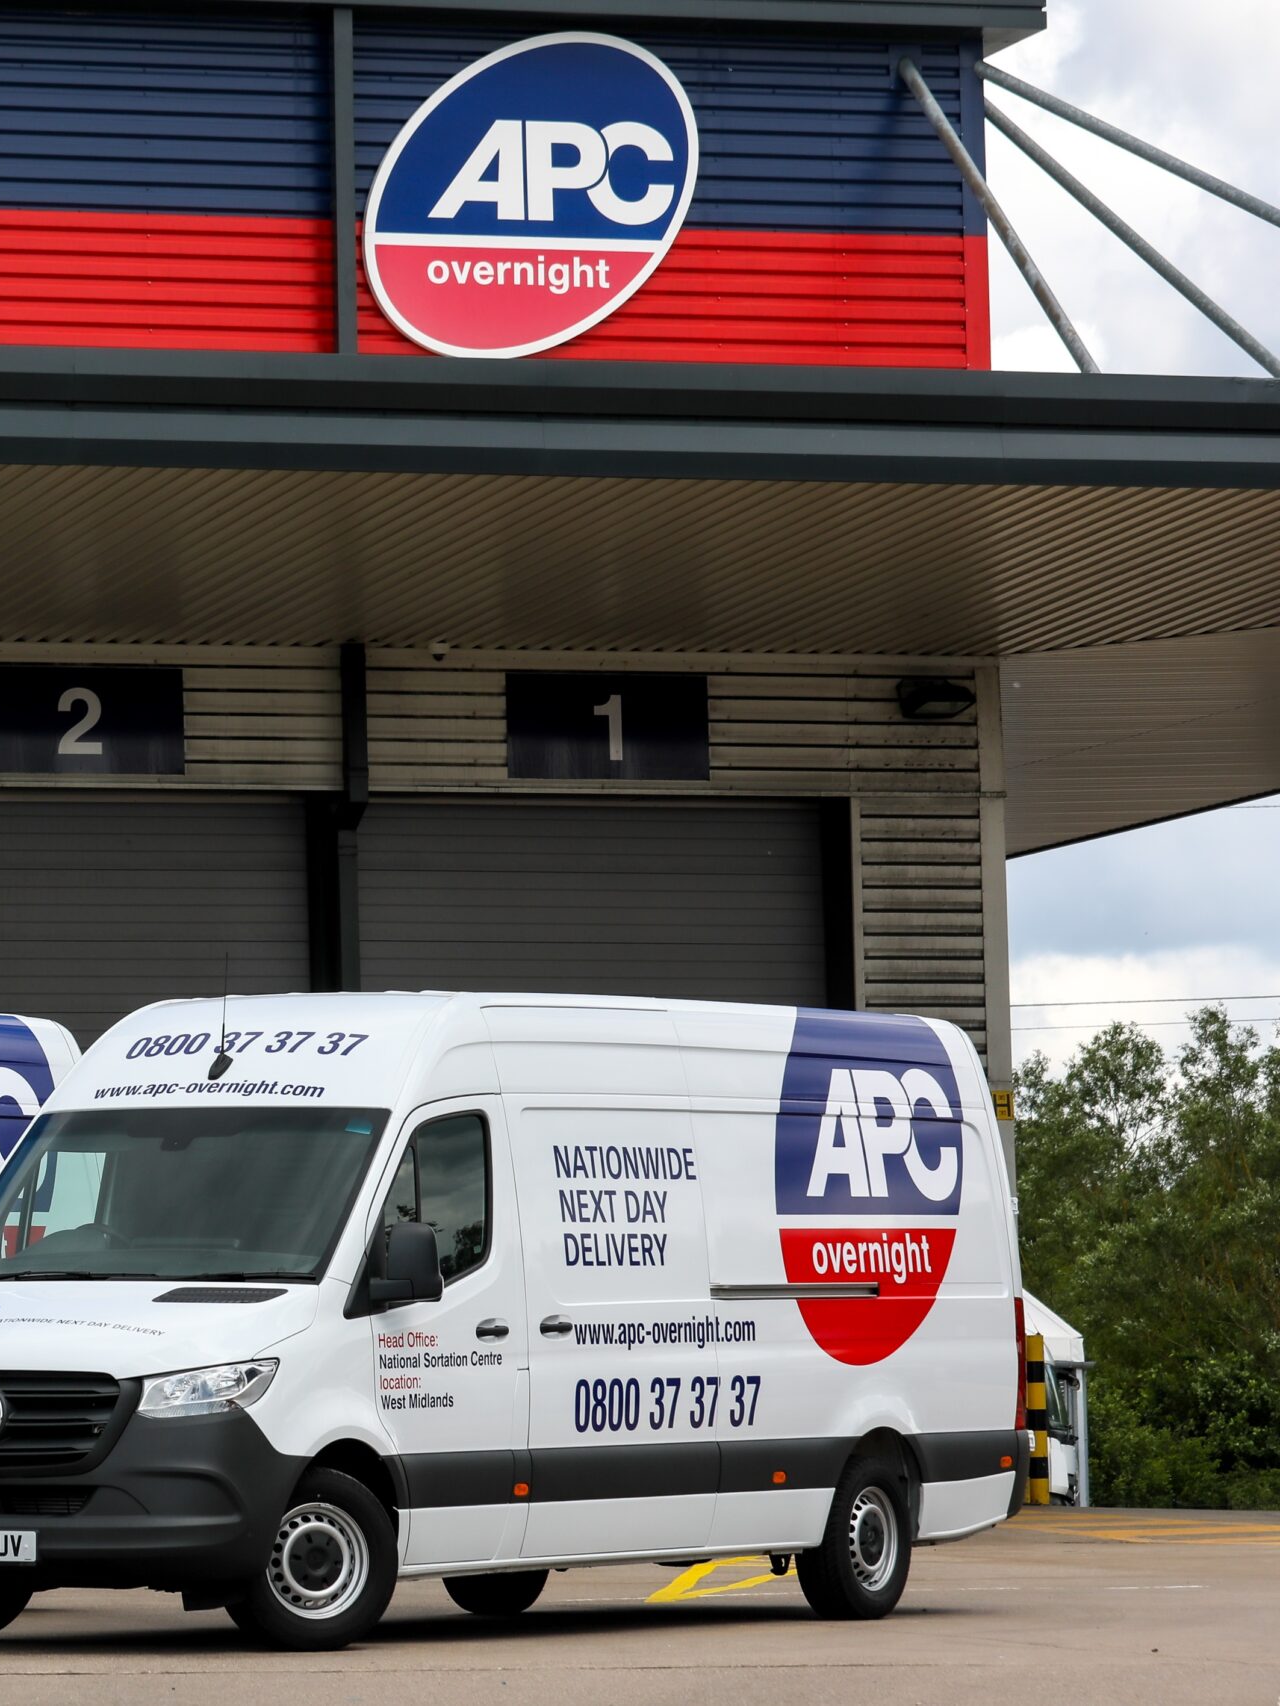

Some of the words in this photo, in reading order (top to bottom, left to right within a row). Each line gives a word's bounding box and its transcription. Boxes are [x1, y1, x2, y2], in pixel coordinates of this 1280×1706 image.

[427, 119, 675, 226] APC
[426, 254, 610, 295] overnight
[56, 686, 104, 755] 2
[592, 693, 624, 761] 1
[125, 1032, 211, 1060] 0800
[213, 1031, 264, 1054] 37
[264, 1031, 316, 1054] 37
[317, 1032, 370, 1056] 37
[94, 1079, 325, 1100] www.apc-overnight.com
[806, 1068, 958, 1202] APC
[553, 1145, 697, 1180] NATIONWIDE
[558, 1189, 616, 1223] NEXT
[623, 1190, 667, 1223] DAY
[563, 1233, 667, 1267] DELIVERY
[812, 1232, 932, 1284] overnight
[112, 1323, 166, 1336] DELIVERY
[378, 1332, 404, 1348] Head
[407, 1332, 439, 1348] Office:
[574, 1315, 756, 1350] www.apc-overnight.com
[379, 1353, 420, 1369] National
[423, 1352, 468, 1368] Sortation
[470, 1351, 503, 1367] Centre
[379, 1374, 422, 1390] location:
[380, 1394, 406, 1410] West
[408, 1392, 454, 1409] Midlands
[574, 1377, 640, 1433] 0800
[649, 1376, 681, 1430] 37
[689, 1376, 721, 1429] 37
[729, 1375, 761, 1428] 37
